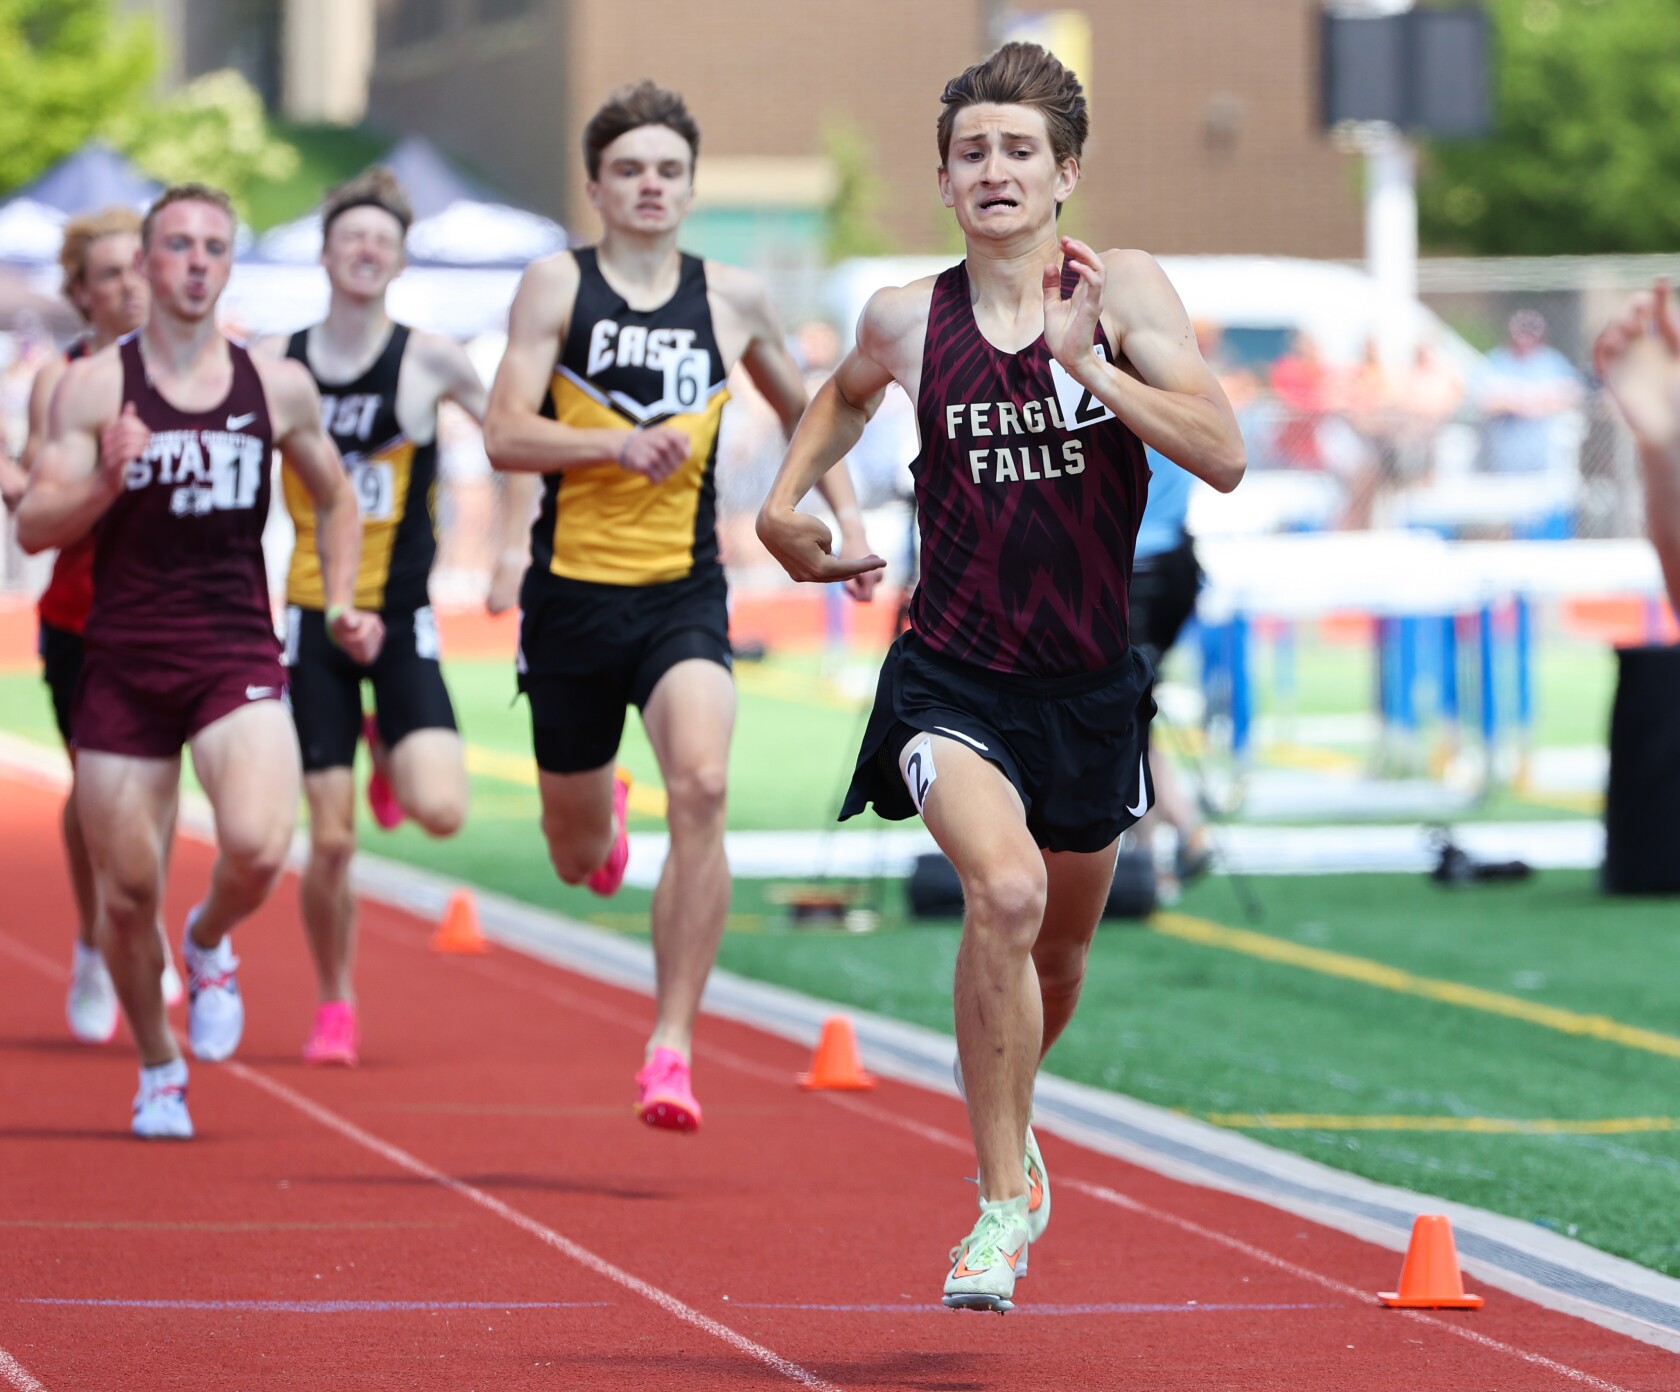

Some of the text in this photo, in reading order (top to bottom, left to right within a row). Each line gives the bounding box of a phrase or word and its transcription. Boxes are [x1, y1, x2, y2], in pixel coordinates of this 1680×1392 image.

[587, 319, 697, 377] EAST
[677, 356, 698, 406] 6
[320, 393, 382, 441] ST
[946, 396, 1067, 439] FERGU
[969, 439, 1086, 484] FALLS
[361, 466, 381, 510] 9
[907, 752, 929, 808] 2
